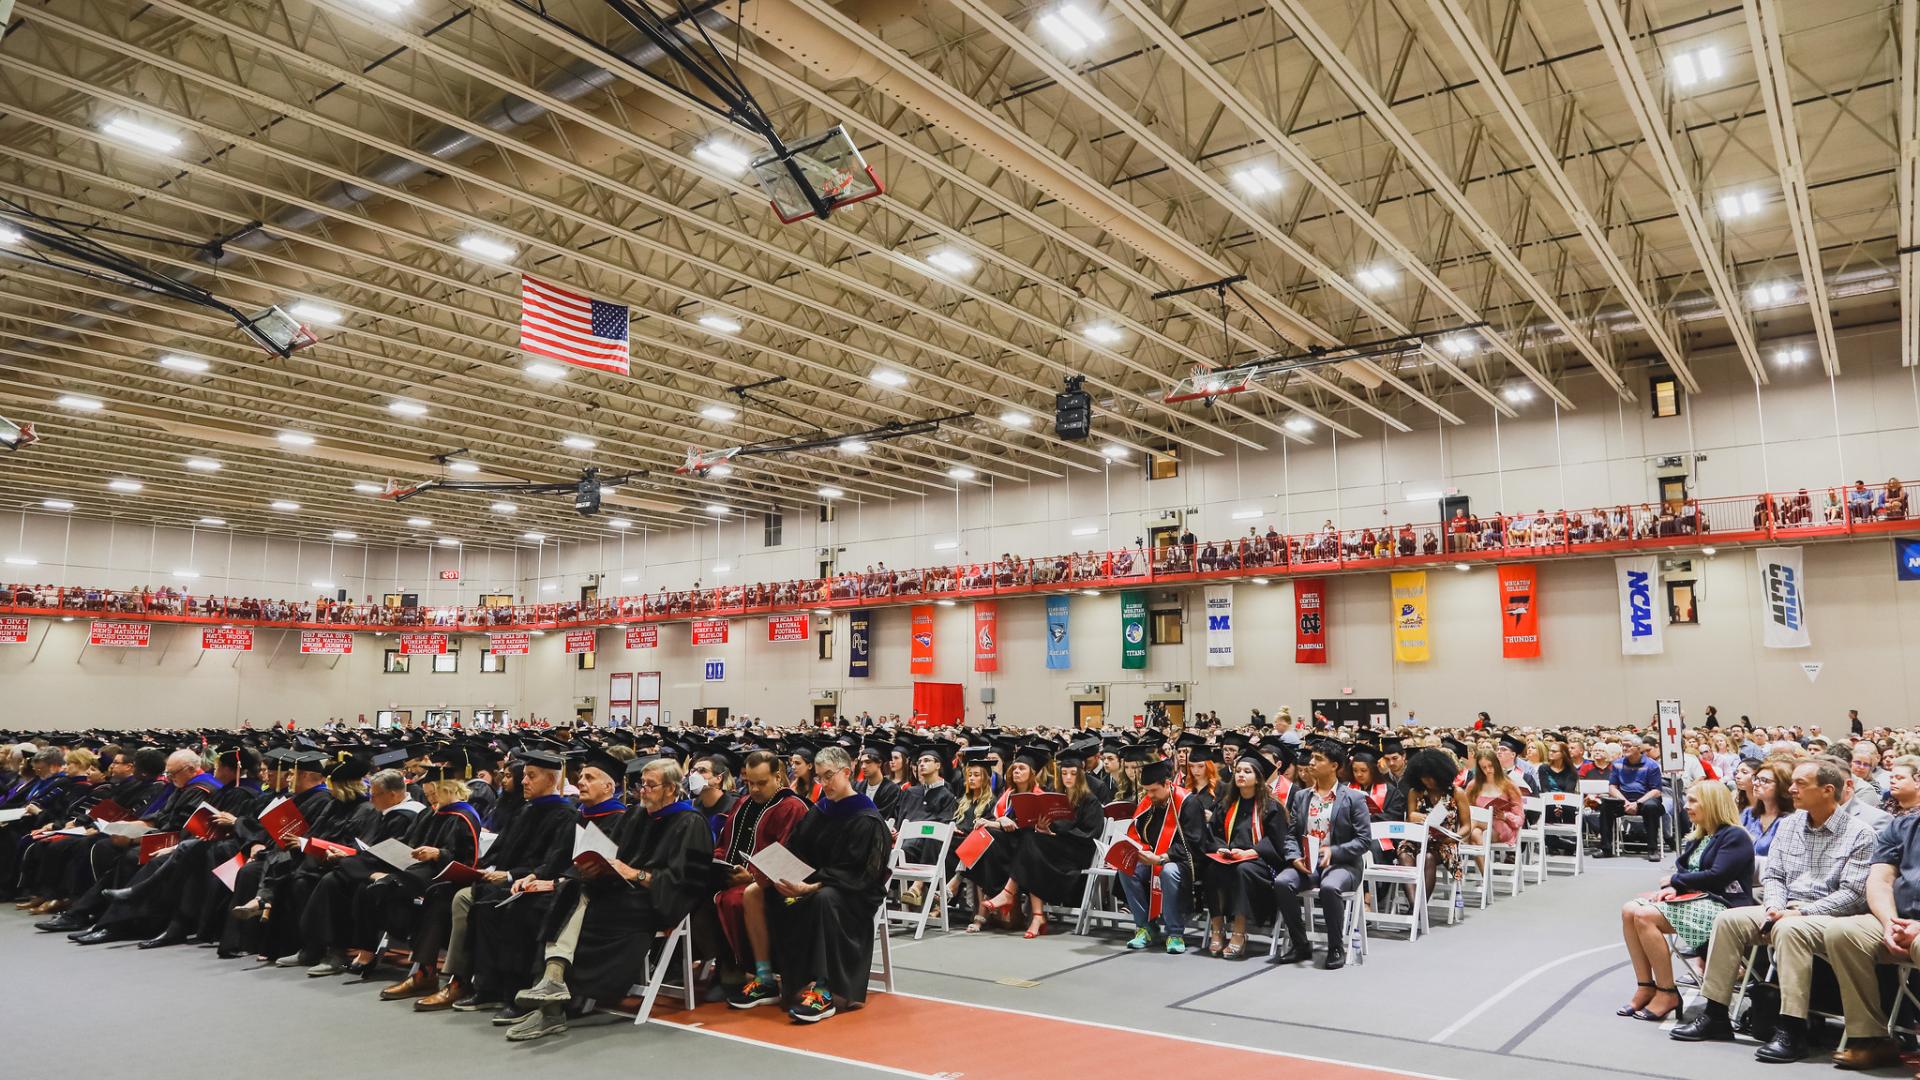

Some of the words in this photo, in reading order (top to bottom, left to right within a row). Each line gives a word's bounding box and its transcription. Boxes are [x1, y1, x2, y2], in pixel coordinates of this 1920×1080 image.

[1627, 570, 1653, 637] NCAA
[1209, 615, 1230, 631] M
[1504, 635, 1537, 643] THUNDER
